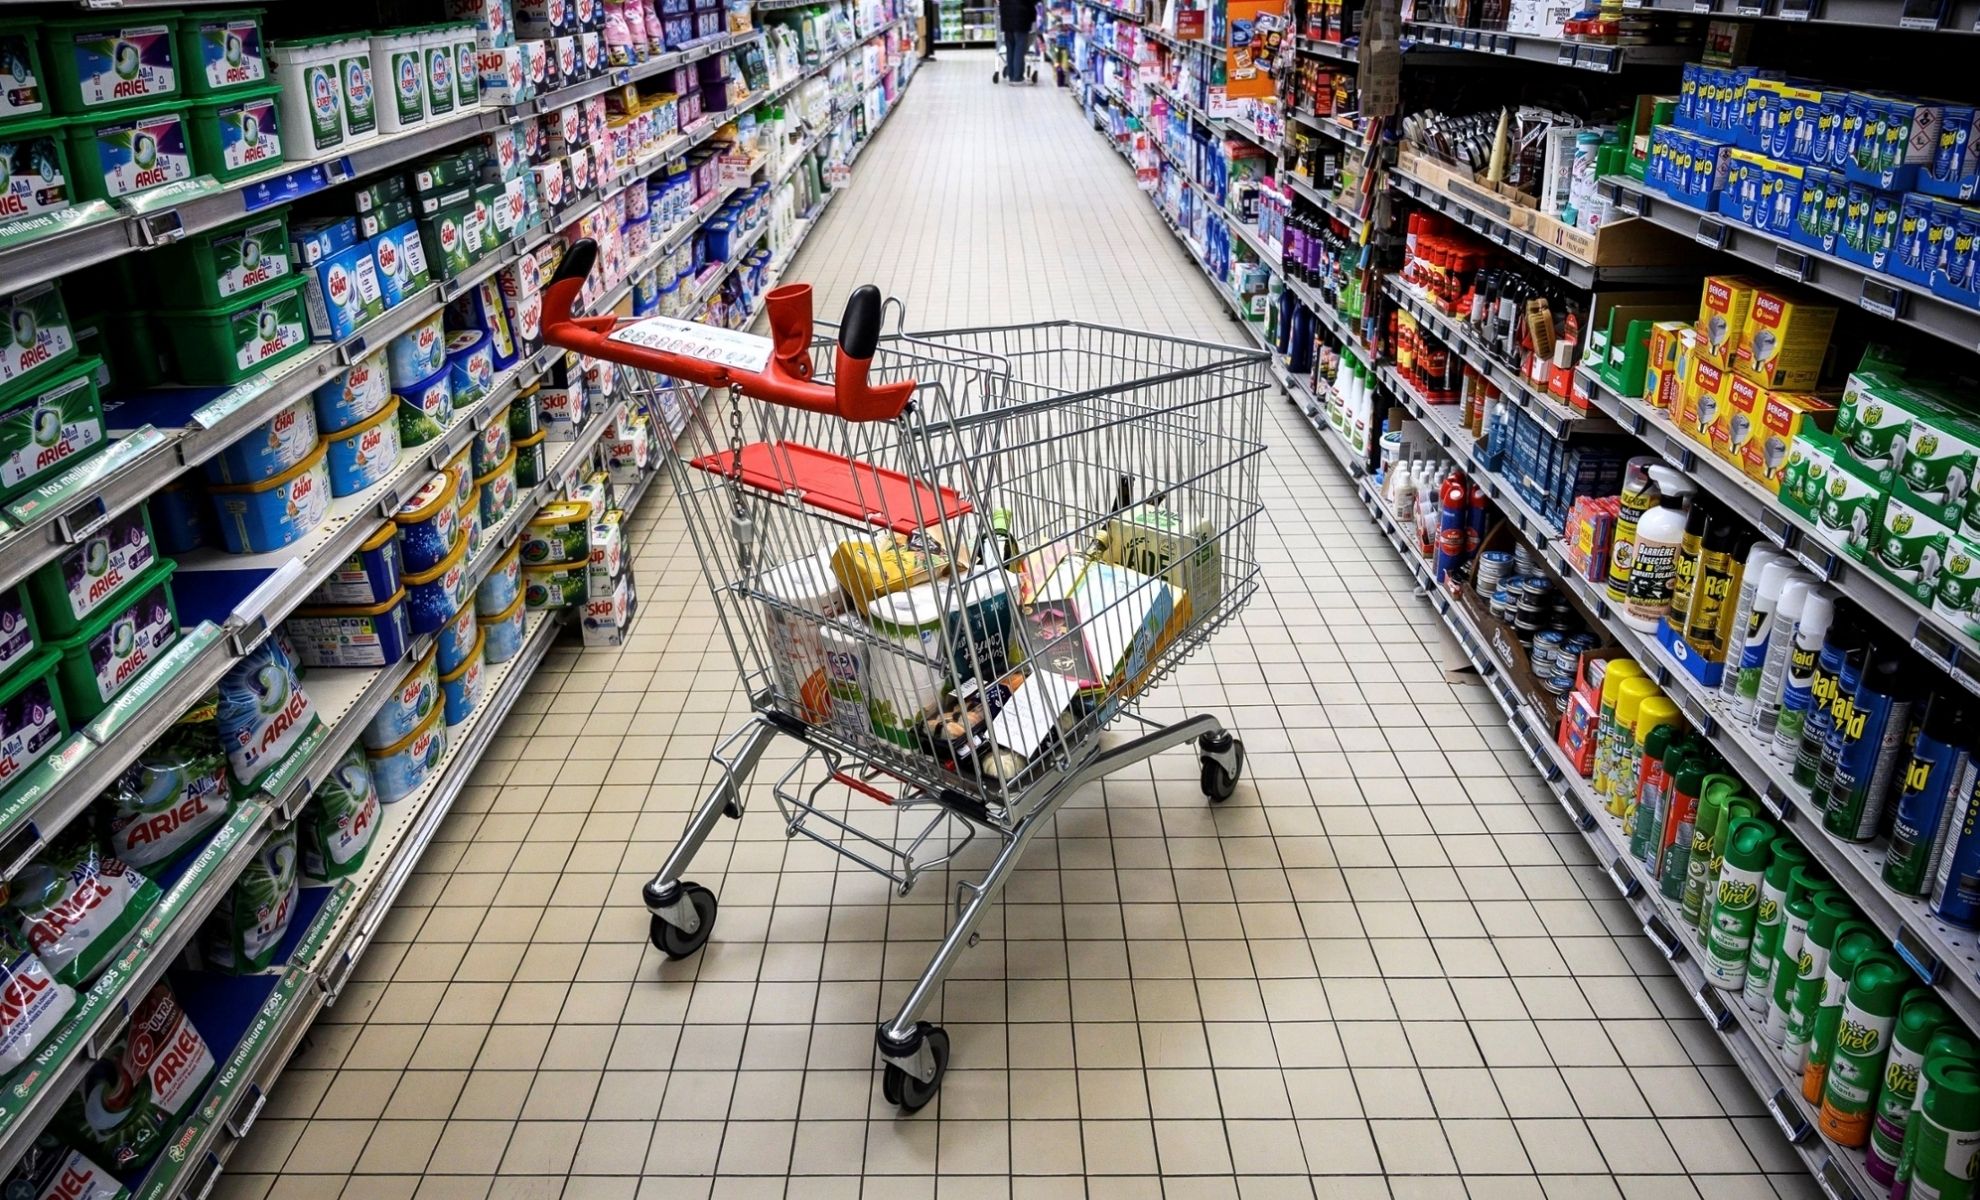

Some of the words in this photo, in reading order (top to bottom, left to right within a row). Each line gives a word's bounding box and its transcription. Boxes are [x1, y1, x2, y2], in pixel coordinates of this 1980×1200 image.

[477, 52, 503, 72] Skip
[226, 67, 249, 82] ARIEL
[114, 79, 149, 98] ARIEL
[244, 148, 266, 163] ARIEL
[135, 168, 168, 188] ARIEL
[0, 195, 28, 216] RIEL
[0, 216, 53, 237] meilleures
[442, 228, 455, 244] CHAT
[380, 251, 396, 267] CHAT
[243, 268, 269, 287] ARIEL
[330, 279, 347, 296] CHAT
[1708, 284, 1728, 300] BENGAL
[1757, 296, 1780, 314] BENGAL
[260, 338, 286, 358] ARIEL
[419, 331, 434, 347] CHAT
[20, 347, 51, 371] ARIEL
[469, 359, 483, 372] CHAT
[350, 369, 369, 388] CHAT
[1699, 363, 1719, 380] BENGAL
[1662, 374, 1671, 400] BENGAL
[1733, 381, 1754, 399] BENGAL
[425, 393, 439, 408] CHAT
[543, 394, 568, 410] Skip
[274, 413, 295, 432] CHAT
[1767, 402, 1789, 422] BENGAL
[361, 432, 381, 451] CHAT
[612, 444, 632, 458] Skip
[37, 440, 75, 470] ARIEL
[38, 482, 62, 498] Nos
[63, 457, 107, 486] meilleures
[292, 479, 312, 500] CHAT
[1639, 543, 1675, 556] BARRIÈRE
[1641, 555, 1671, 566] INSECTES
[1678, 556, 1698, 576] Rai
[89, 569, 124, 602] ARIEL
[587, 601, 612, 616] Skip
[963, 632, 1001, 659] Confot
[116, 649, 147, 684] ARIEL
[1791, 648, 1813, 666] Raid
[115, 693, 135, 710] Nos
[133, 655, 173, 695] meilleures
[404, 682, 421, 703] CHAT
[1812, 669, 1838, 698] Rai
[262, 691, 308, 753] ARIEL
[1846, 710, 1866, 739] id
[414, 734, 430, 756] CHAT
[263, 774, 278, 791] Nos
[276, 750, 300, 780] meilleures
[1907, 761, 1930, 790] id
[18, 785, 40, 806] temps
[127, 798, 208, 850] ARIEL
[160, 892, 179, 914] Nos
[178, 849, 215, 893] meilleures
[1718, 881, 1756, 905] Pyrel
[298, 944, 310, 959] Nos
[307, 912, 330, 946] meilleures
[151, 997, 173, 1032] ULTRA
[1837, 1018, 1879, 1051] Pyrel
[36, 1044, 59, 1066] Nos
[153, 1028, 199, 1096] ARIEL
[220, 1071, 234, 1087] Nos
[234, 1018, 266, 1069] meilleures
[1887, 1063, 1920, 1092] Pyre
